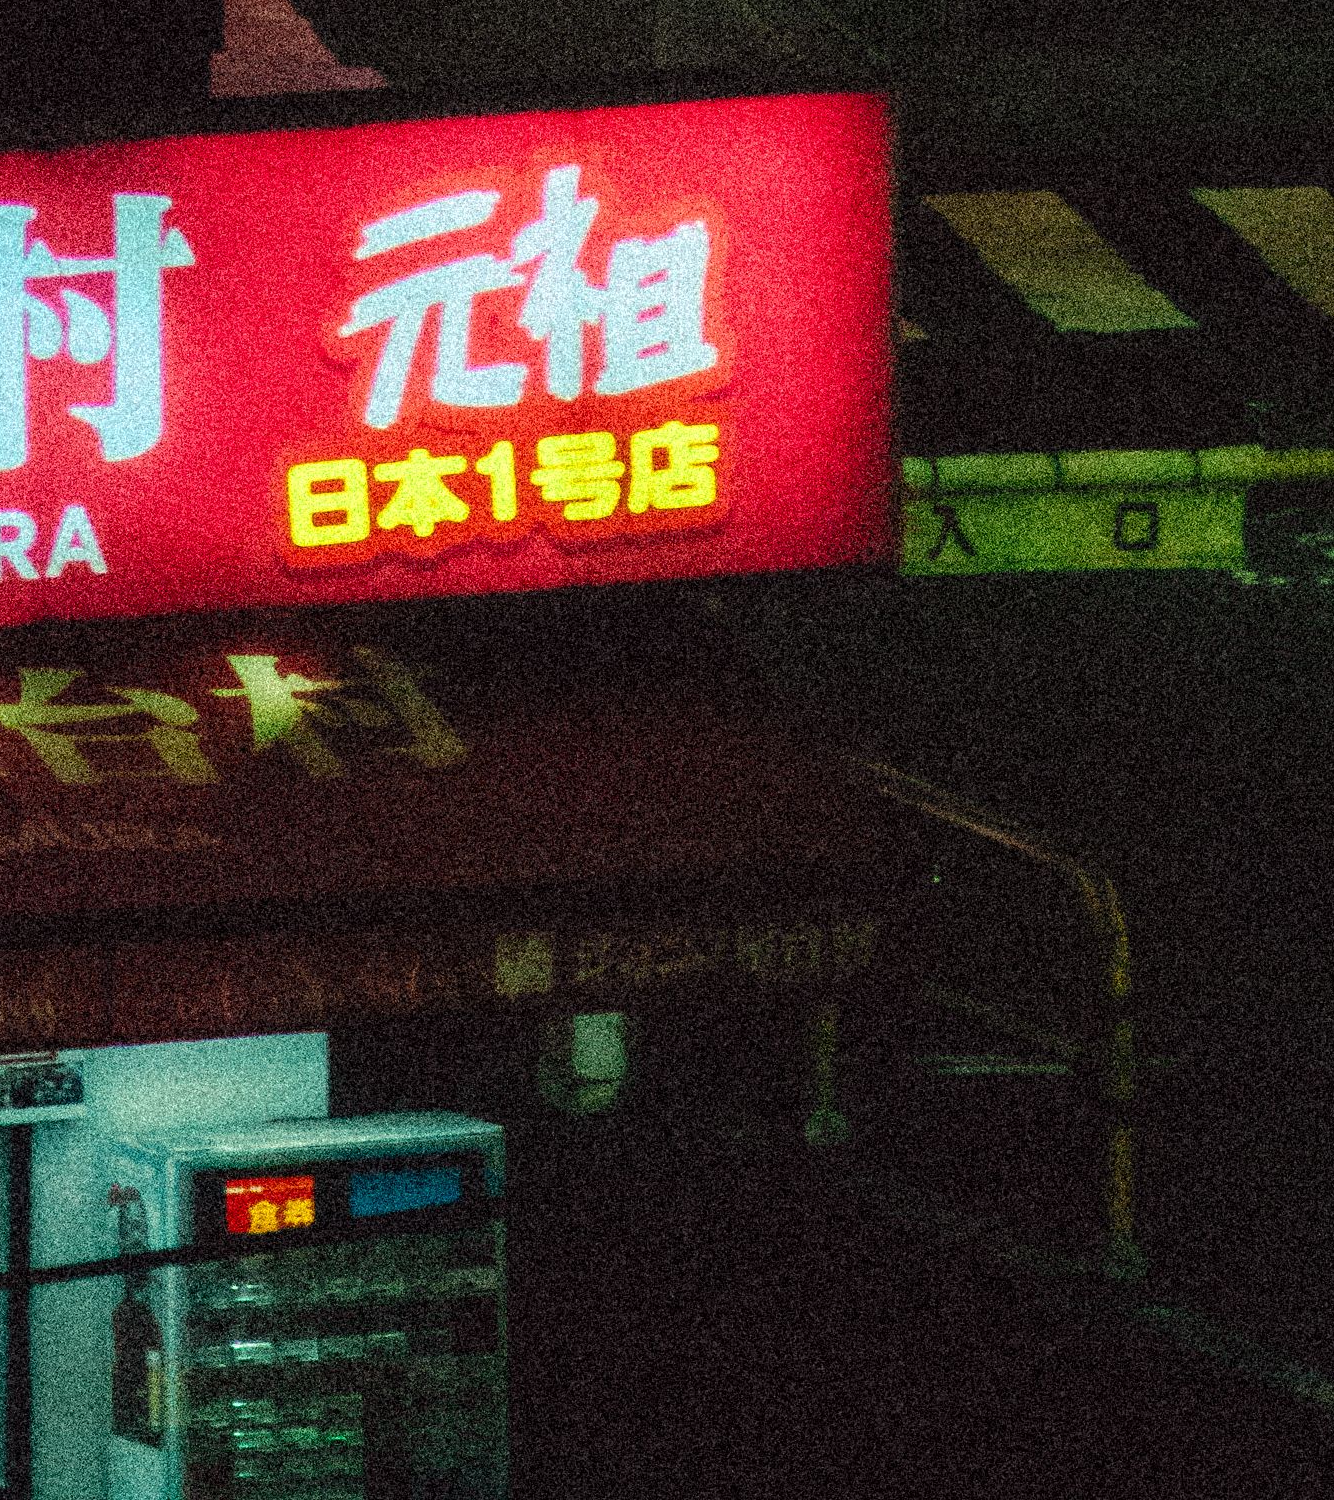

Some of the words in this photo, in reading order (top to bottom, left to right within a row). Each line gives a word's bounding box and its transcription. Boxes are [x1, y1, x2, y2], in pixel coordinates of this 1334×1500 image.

[338, 163, 719, 430] 元祖
[285, 420, 721, 548] 日本1号店
